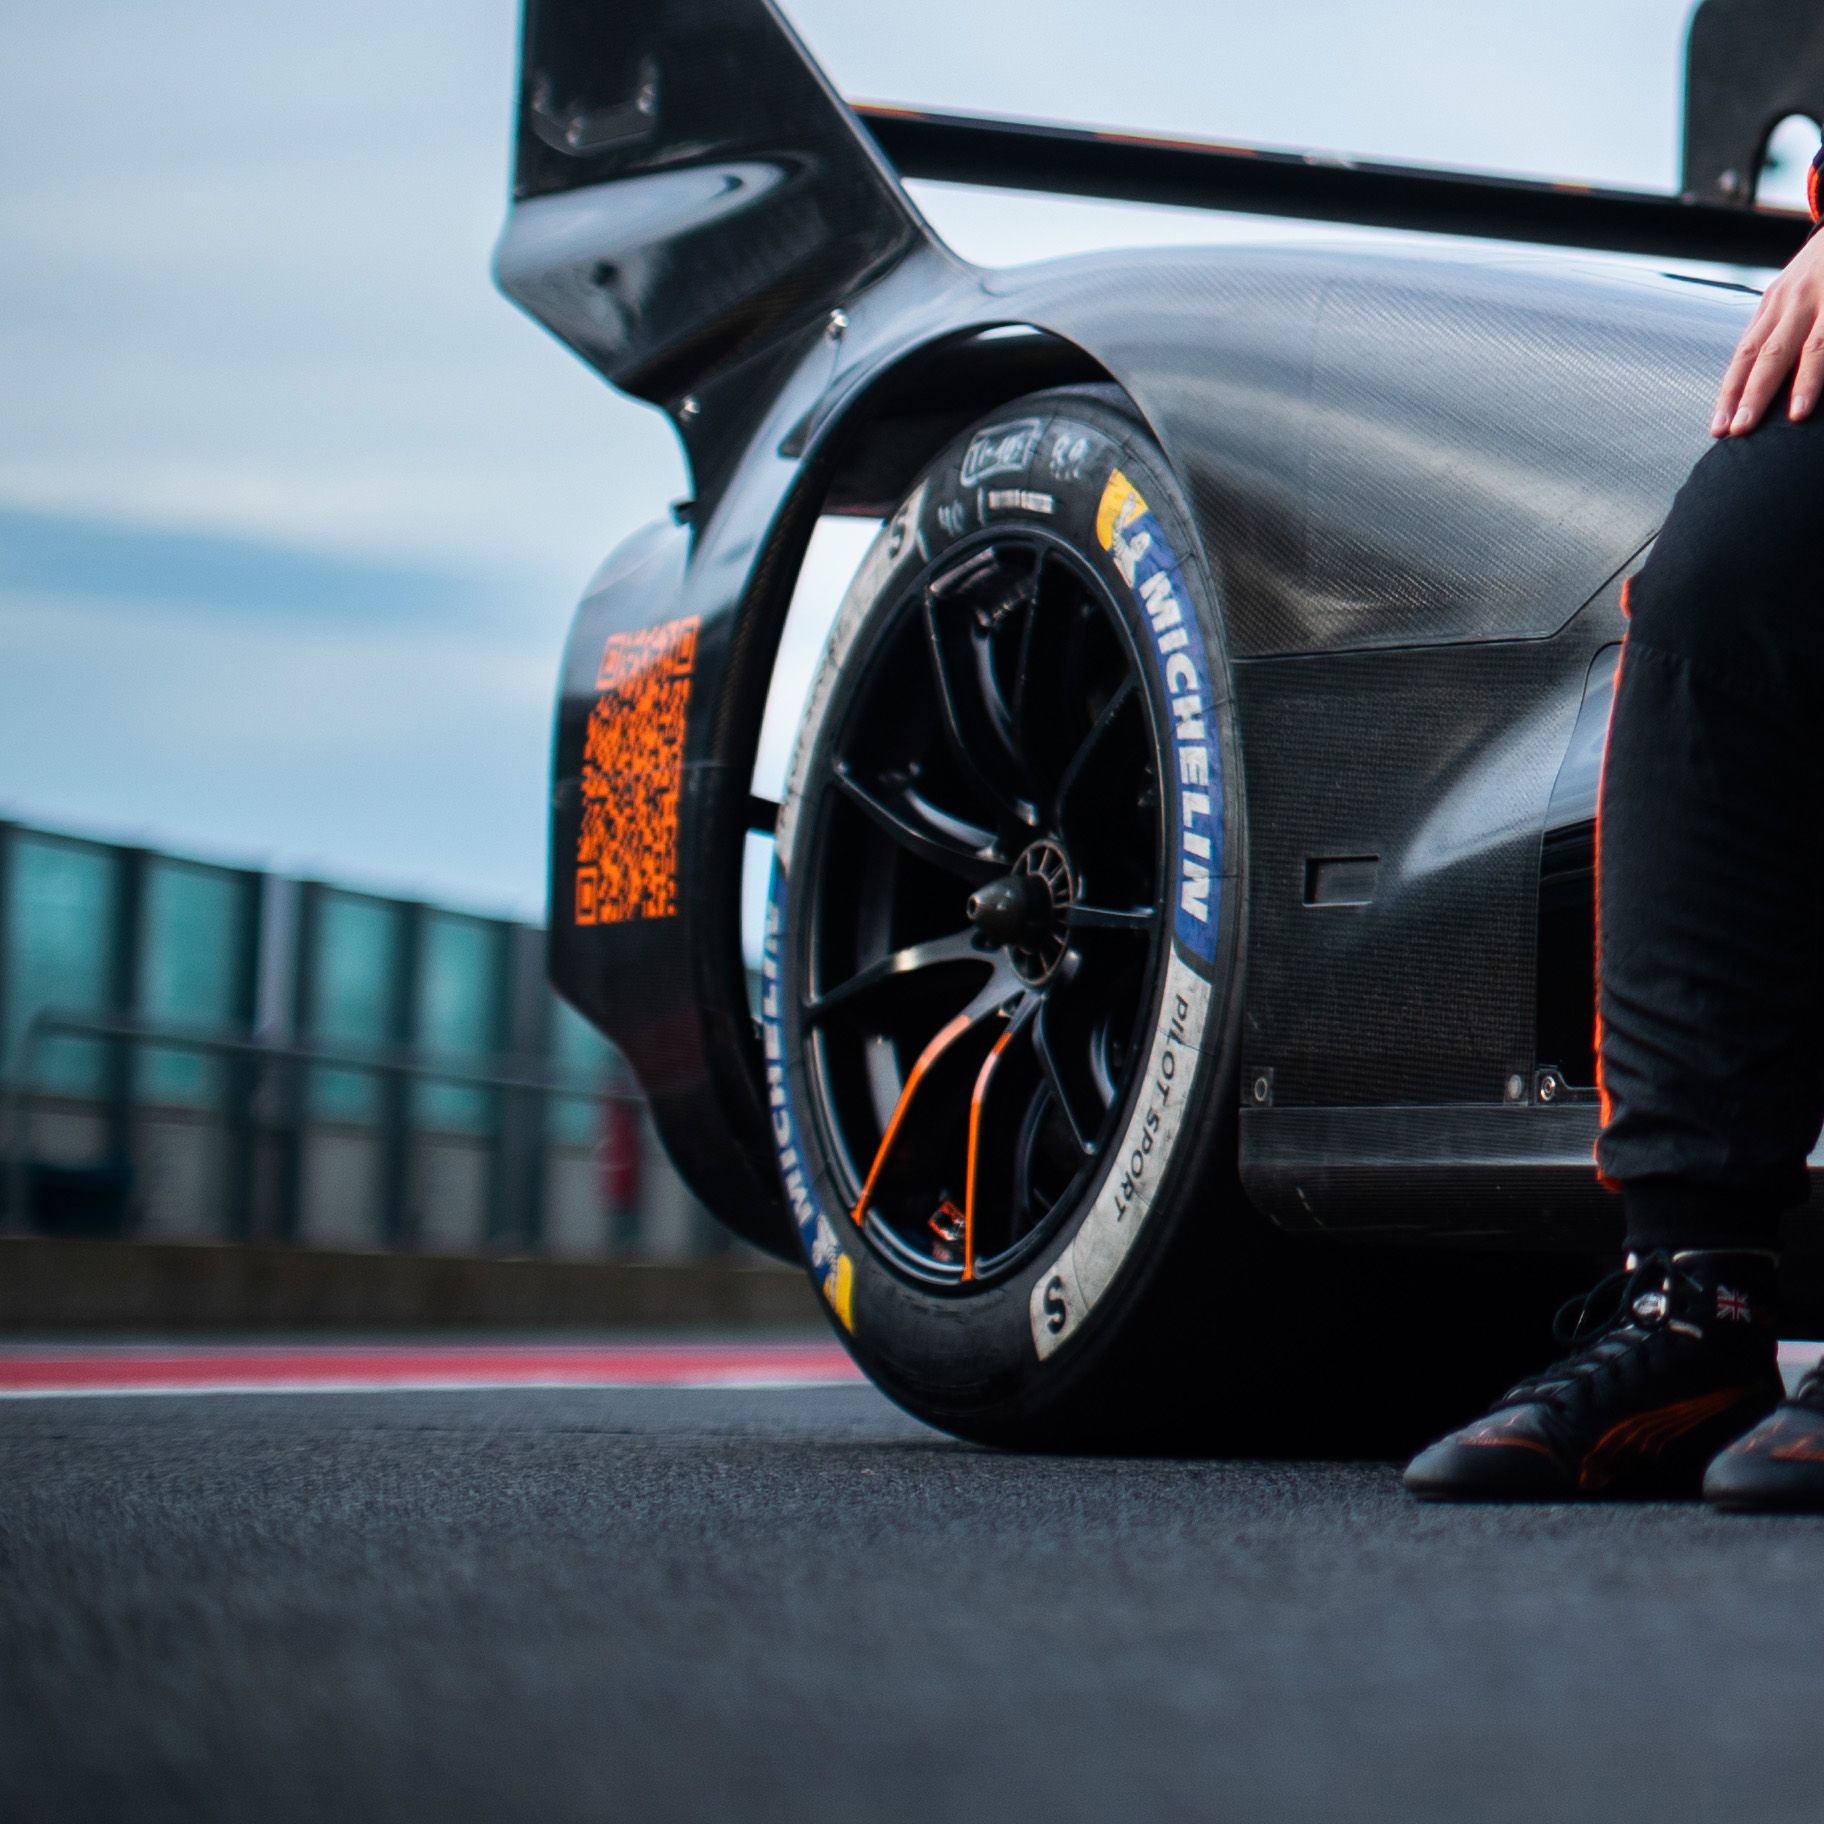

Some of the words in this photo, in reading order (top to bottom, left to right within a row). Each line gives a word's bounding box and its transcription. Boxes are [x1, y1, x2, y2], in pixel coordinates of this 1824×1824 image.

[1137, 570, 1213, 925] MICHELIN
[1156, 993, 1190, 1107] PILOT
[1114, 1106, 1161, 1223] SPORT
[1043, 1274, 1068, 1335] S
